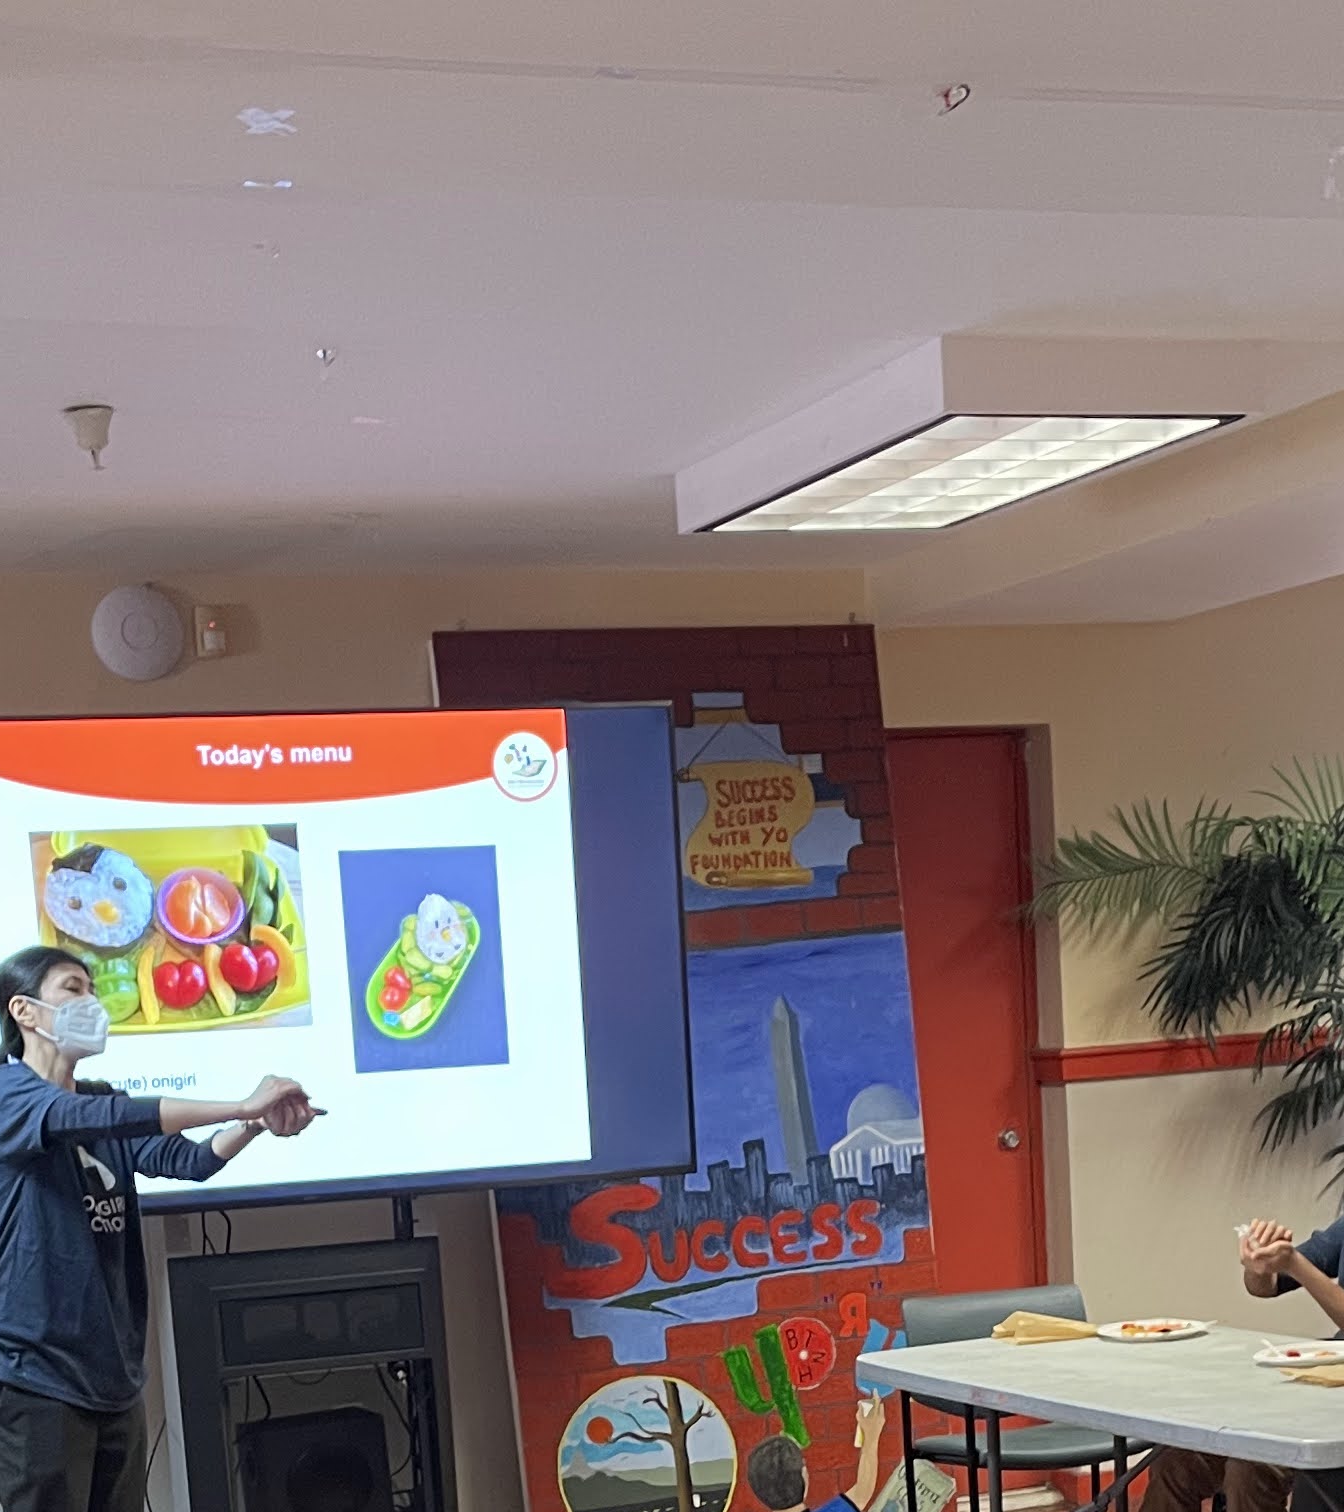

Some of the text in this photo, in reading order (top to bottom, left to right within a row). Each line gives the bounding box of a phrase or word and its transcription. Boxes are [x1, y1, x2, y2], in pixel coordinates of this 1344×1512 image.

[195, 743, 353, 769] Today's menu
[716, 776, 795, 808] SUCCESS
[714, 804, 778, 828] BEGINS
[708, 830, 751, 847] WITH
[690, 850, 792, 875] FOUNDATION
[151, 1072, 197, 1091] onigiri
